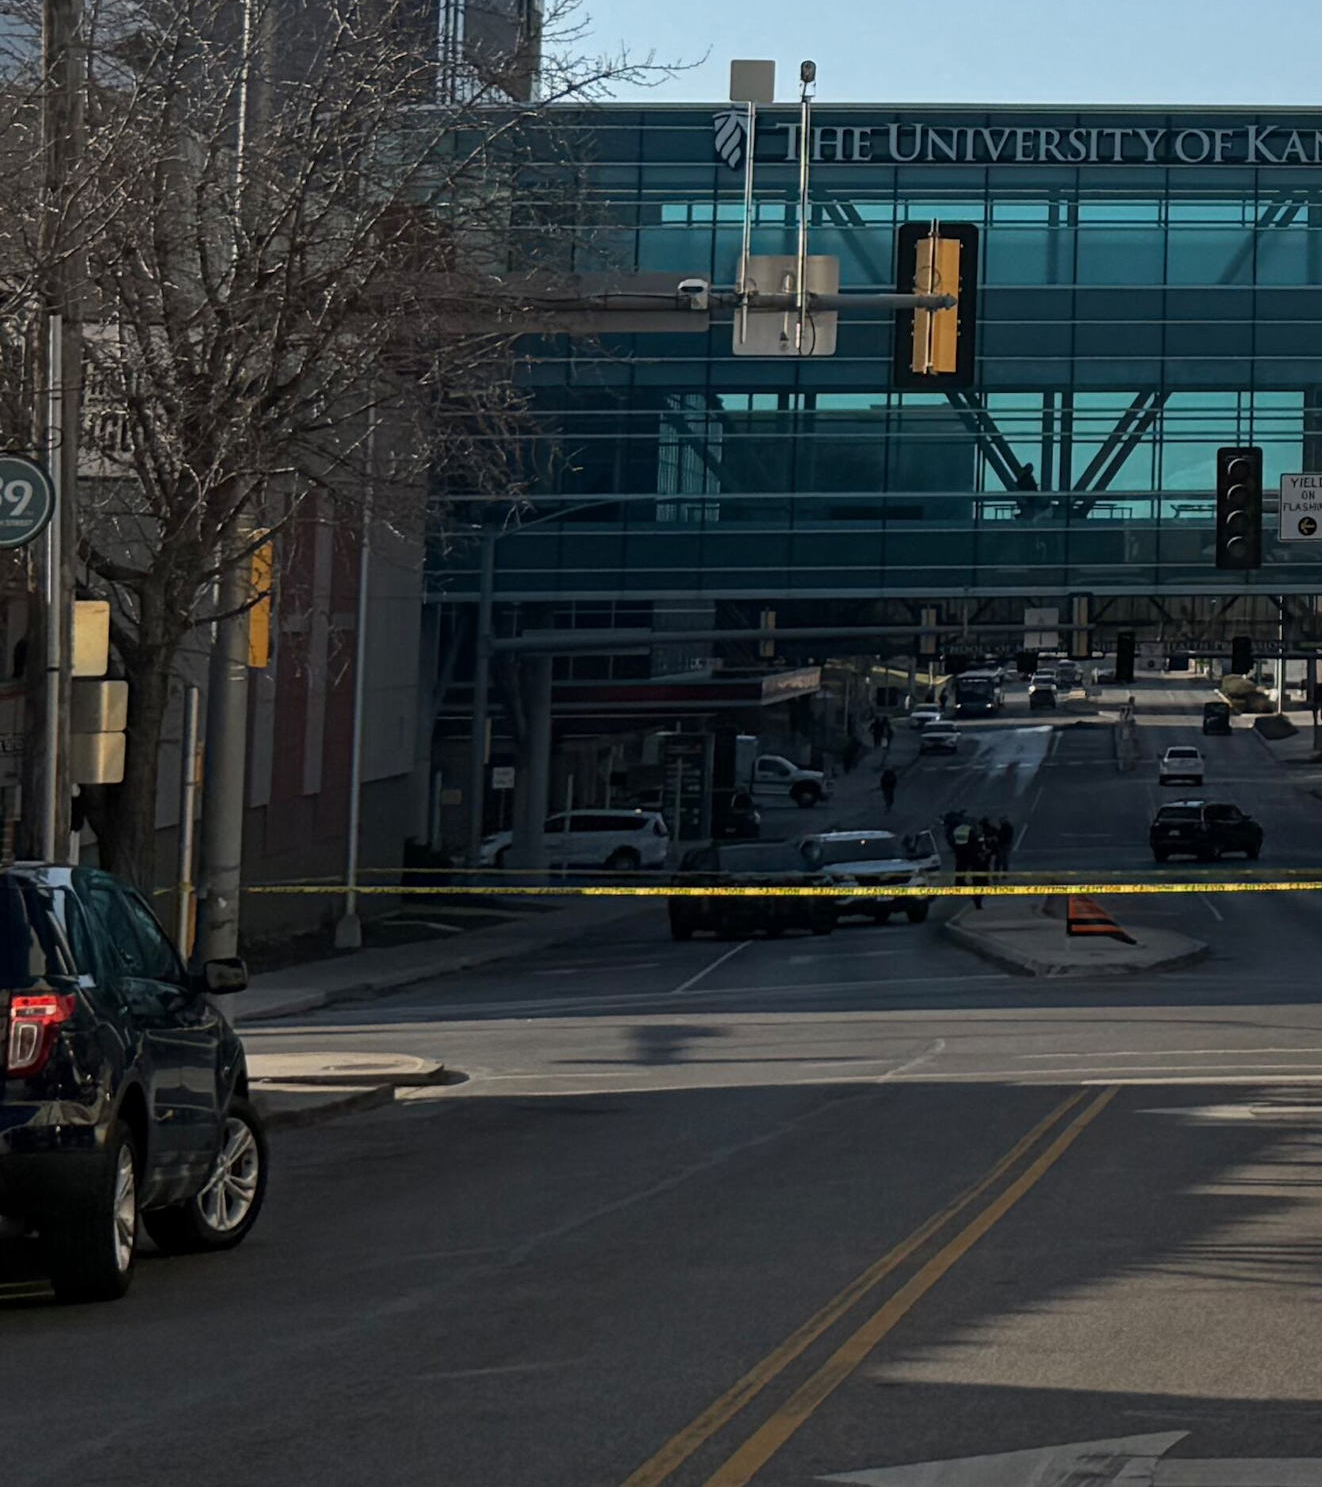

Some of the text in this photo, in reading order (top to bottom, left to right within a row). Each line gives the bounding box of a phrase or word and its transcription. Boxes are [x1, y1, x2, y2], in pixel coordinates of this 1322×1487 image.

[776, 122, 873, 162] THE
[887, 122, 1173, 164] UNIVERSITY
[1174, 128, 1234, 163] OF
[0, 476, 34, 517] 9
[1301, 490, 1316, 500] ON
